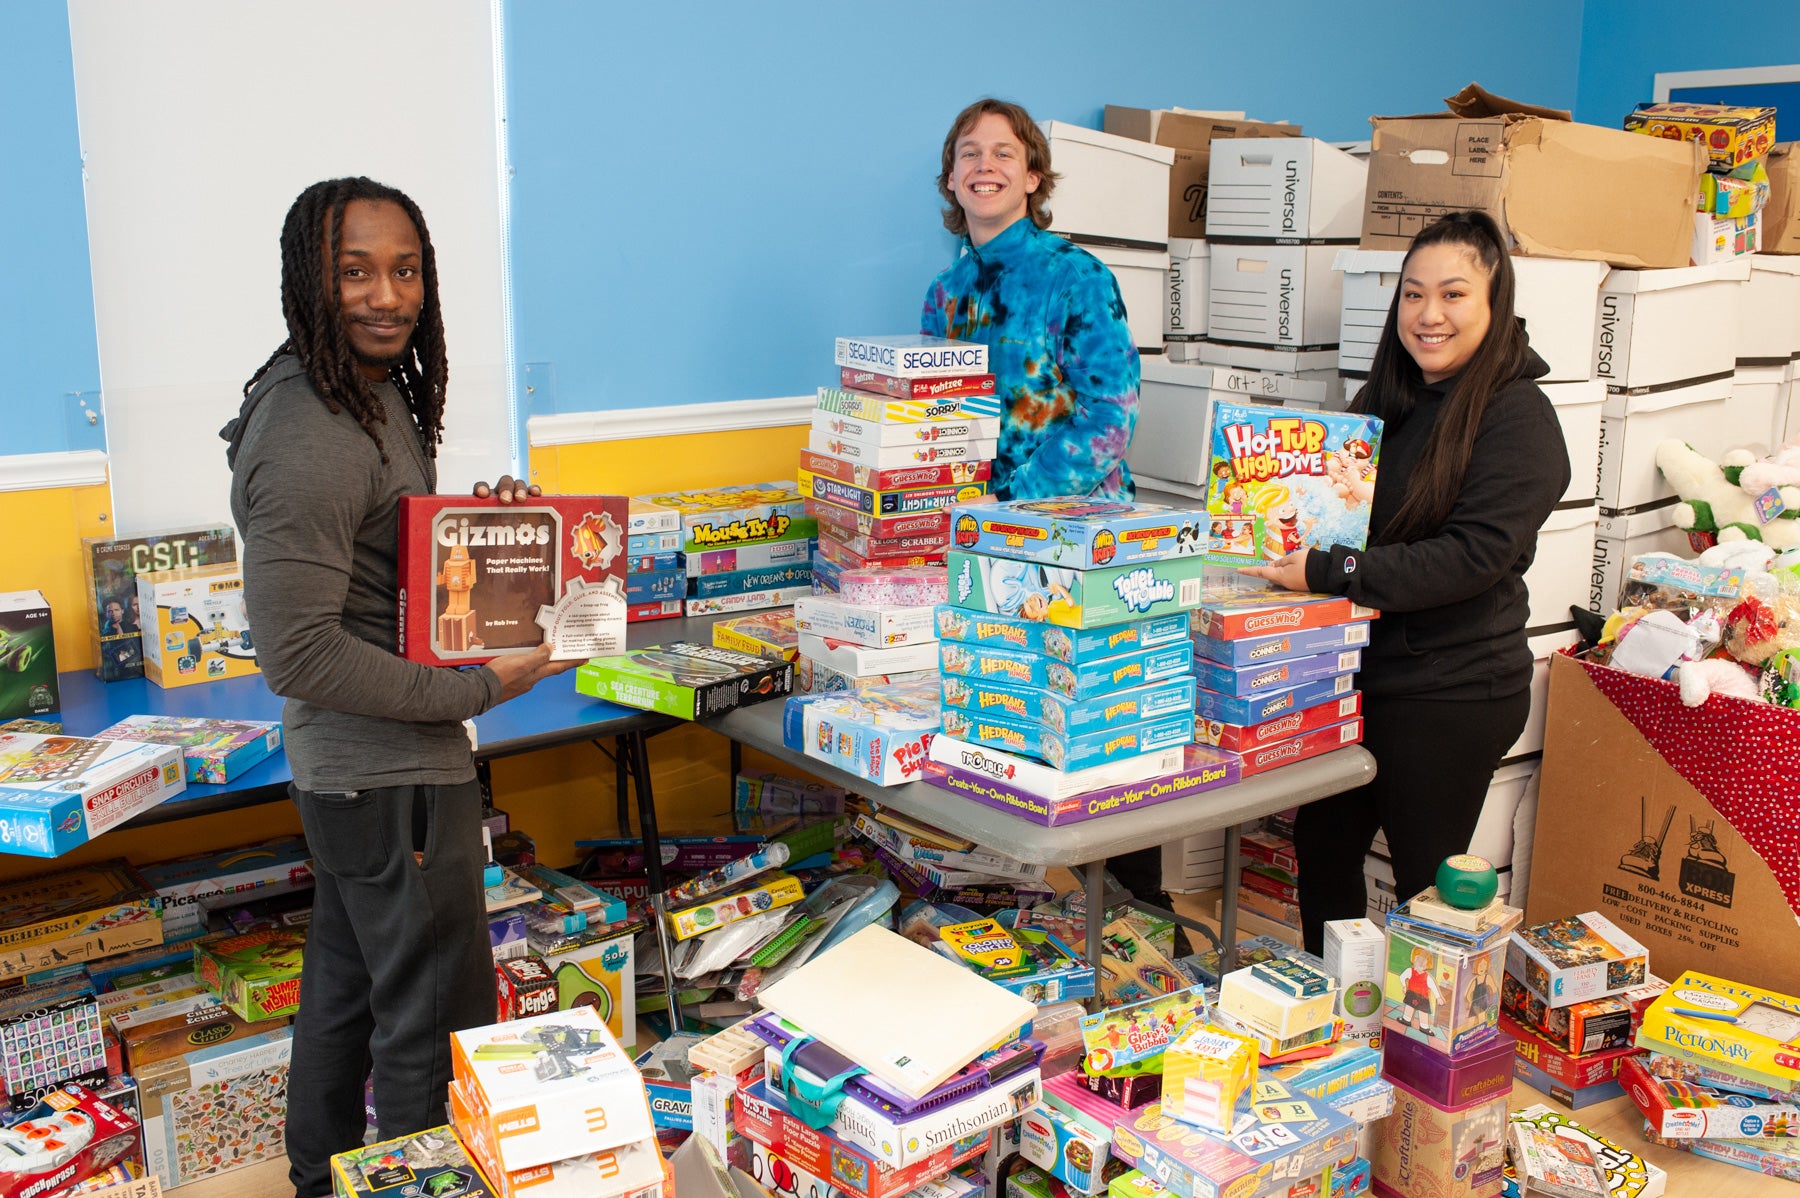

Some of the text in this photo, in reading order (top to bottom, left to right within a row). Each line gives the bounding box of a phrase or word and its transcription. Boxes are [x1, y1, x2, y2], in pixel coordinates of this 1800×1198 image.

[1377, 190, 1404, 199] CONTENTS
[849, 342, 895, 366] SEQUENCE
[903, 349, 983, 370] SEQUENCE
[854, 372, 875, 383] Yahtzee
[929, 379, 963, 395] Yahtzee
[841, 400, 863, 411] SORRY!
[925, 403, 960, 418] SORRY!
[938, 427, 968, 438] CONNECT
[936, 447, 966, 458] CONNECT
[913, 490, 934, 498] GROWING
[437, 518, 550, 547] Gizmos
[100, 543, 131, 553] CRIME STORIES
[901, 537, 944, 547] SCRABBLE
[132, 540, 199, 574] CSI:
[211, 581, 241, 591] TOMO
[743, 575, 759, 590] NEW
[1114, 569, 1155, 597] Toilet
[721, 593, 765, 605] CANDY LAND
[1125, 579, 1175, 612] Trouble
[398, 588, 407, 654] Gizmos
[844, 616, 876, 633] FROZEN
[1247, 609, 1303, 631] Guess Who?
[976, 622, 1027, 640] HEDBANZ
[1108, 629, 1137, 648] HEDBANZ
[717, 630, 741, 648] FAMILY
[742, 641, 761, 655] FEUD
[1005, 635, 1028, 646] JUNIOR
[1250, 638, 1290, 659] CONNECT 4
[980, 658, 1031, 675] HEDBANZ
[1009, 669, 1032, 682] JUNIOR
[1113, 664, 1141, 683] HEDBANZ
[1251, 666, 1289, 688] CONNECT 4
[624, 684, 660, 700] CREATURE
[979, 691, 1027, 708] HEDBANZ
[1005, 704, 1027, 717] JUNIOR
[1105, 701, 1137, 721] HEDBANZ
[1262, 692, 1294, 718] CONNECT 4
[978, 724, 1026, 741] HEDBANZ
[1257, 713, 1302, 738] Guess Who?
[1005, 737, 1026, 750] JUNIOR
[1105, 735, 1137, 755] HEDBANZ
[893, 742, 921, 765] Pie
[1256, 742, 1302, 766] Guess Who?
[962, 751, 1004, 778] TROUBLE
[1172, 772, 1201, 791] Ribbon
[1202, 765, 1227, 784] Board
[92, 771, 153, 808] SNAP CIRCUITS
[90, 803, 119, 823] SKILL
[120, 783, 160, 811] BUILDER
[1006, 792, 1028, 810] Ribbon
[1028, 798, 1048, 816] Board
[1638, 884, 1705, 912] 800-466-8844
[1685, 882, 1731, 904] XPRESS
[1605, 885, 1739, 936] FREE DELIVERY & RECYCLING
[953, 921, 989, 932] Crayola
[1602, 896, 1740, 948] LOW COST PACKING SUPPLIES
[1620, 913, 1717, 952] USED BOXES 25% OFF
[962, 938, 1012, 951] COLORED
[969, 943, 1015, 955] PENCILS
[605, 951, 626, 962] 500
[519, 987, 557, 1016] Jenga
[186, 1006, 222, 1018] CHESS
[193, 1025, 230, 1038] CLASSIC
[1132, 1036, 1170, 1054] Bubble
[1665, 1025, 1753, 1062] PICTIONARY
[223, 1065, 243, 1076] Tree
[256, 1056, 273, 1067] Life
[1266, 1085, 1279, 1094] A
[742, 1093, 773, 1120] U.S.A.
[1292, 1105, 1306, 1115] B
[498, 1117, 537, 1132] STEM
[782, 1115, 819, 1141] Extra Large
[925, 1100, 1009, 1148] Smithsonian
[1271, 1127, 1286, 1139] C
[783, 1125, 820, 1149] Floor Puzzle
[1732, 1148, 1759, 1162] LAND
[513, 1167, 549, 1184] STEM
